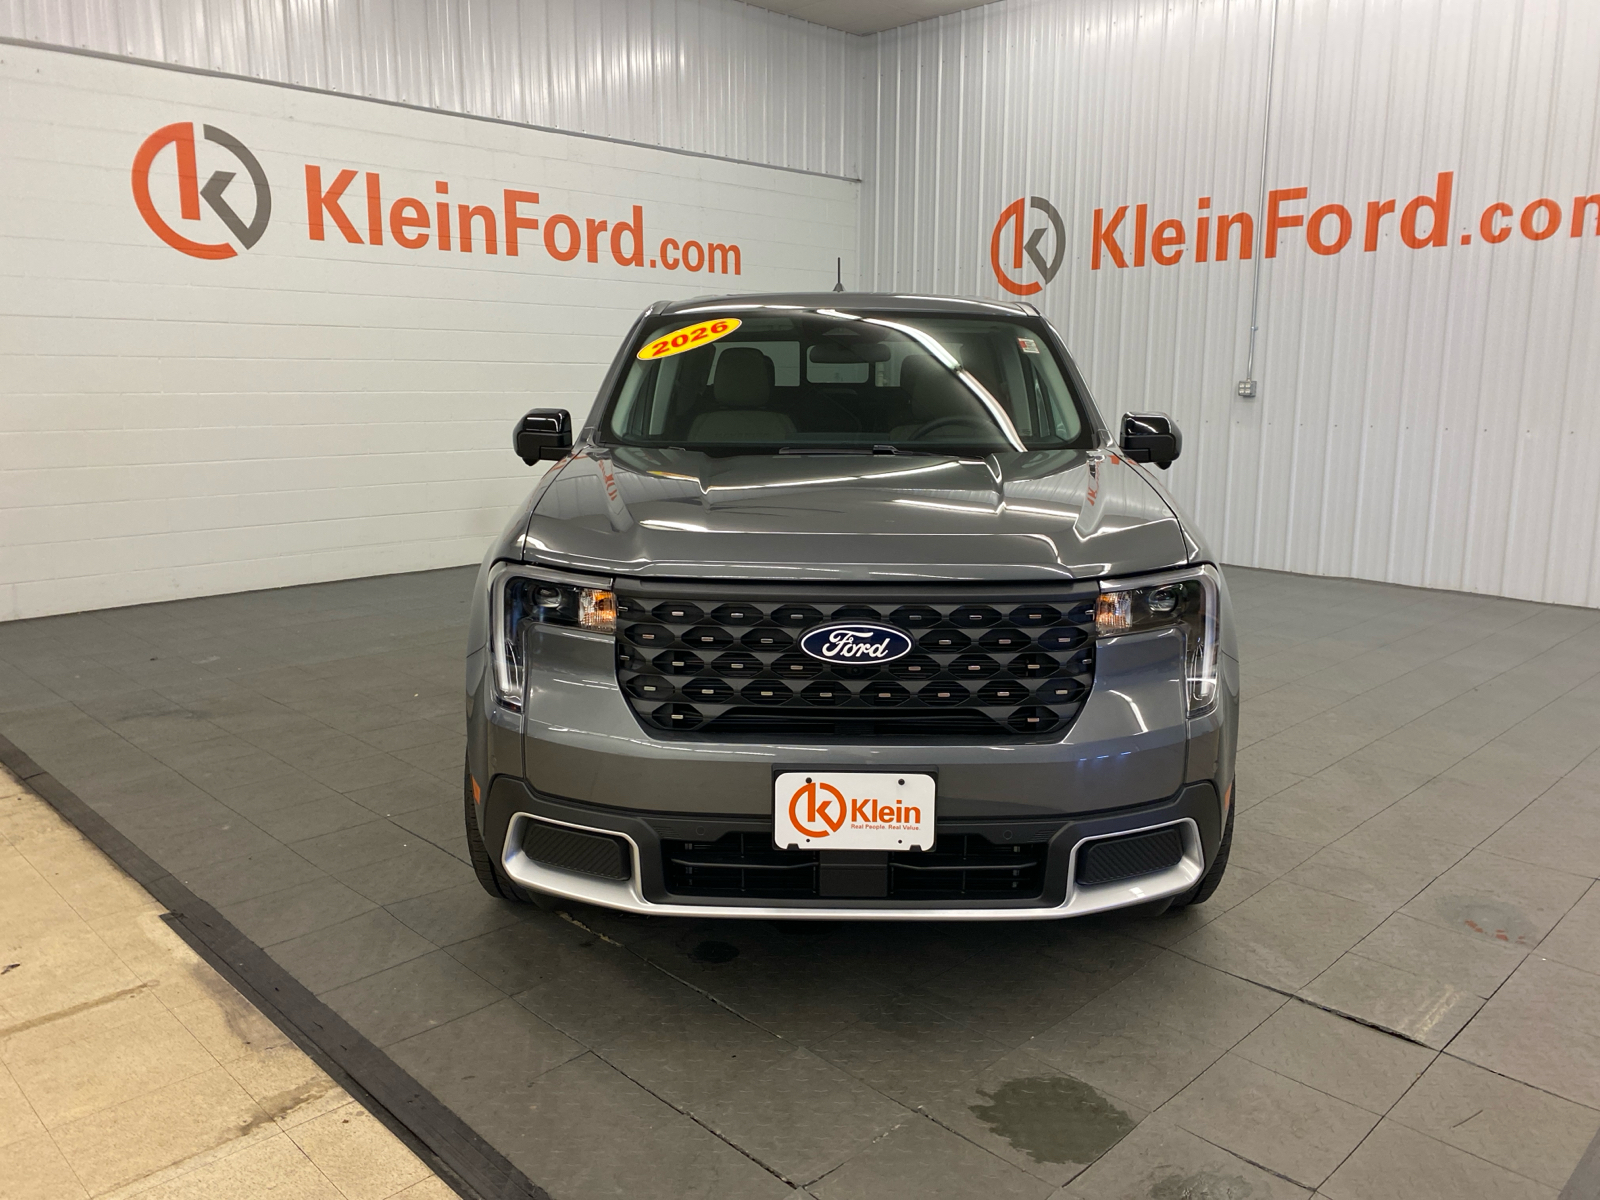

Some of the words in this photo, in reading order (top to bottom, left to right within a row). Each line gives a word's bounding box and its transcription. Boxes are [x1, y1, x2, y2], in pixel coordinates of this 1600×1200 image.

[304, 164, 742, 276] KleinFord.com
[651, 320, 728, 357] 2026
[822, 630, 890, 657] Ford
[851, 798, 921, 823] Klein
